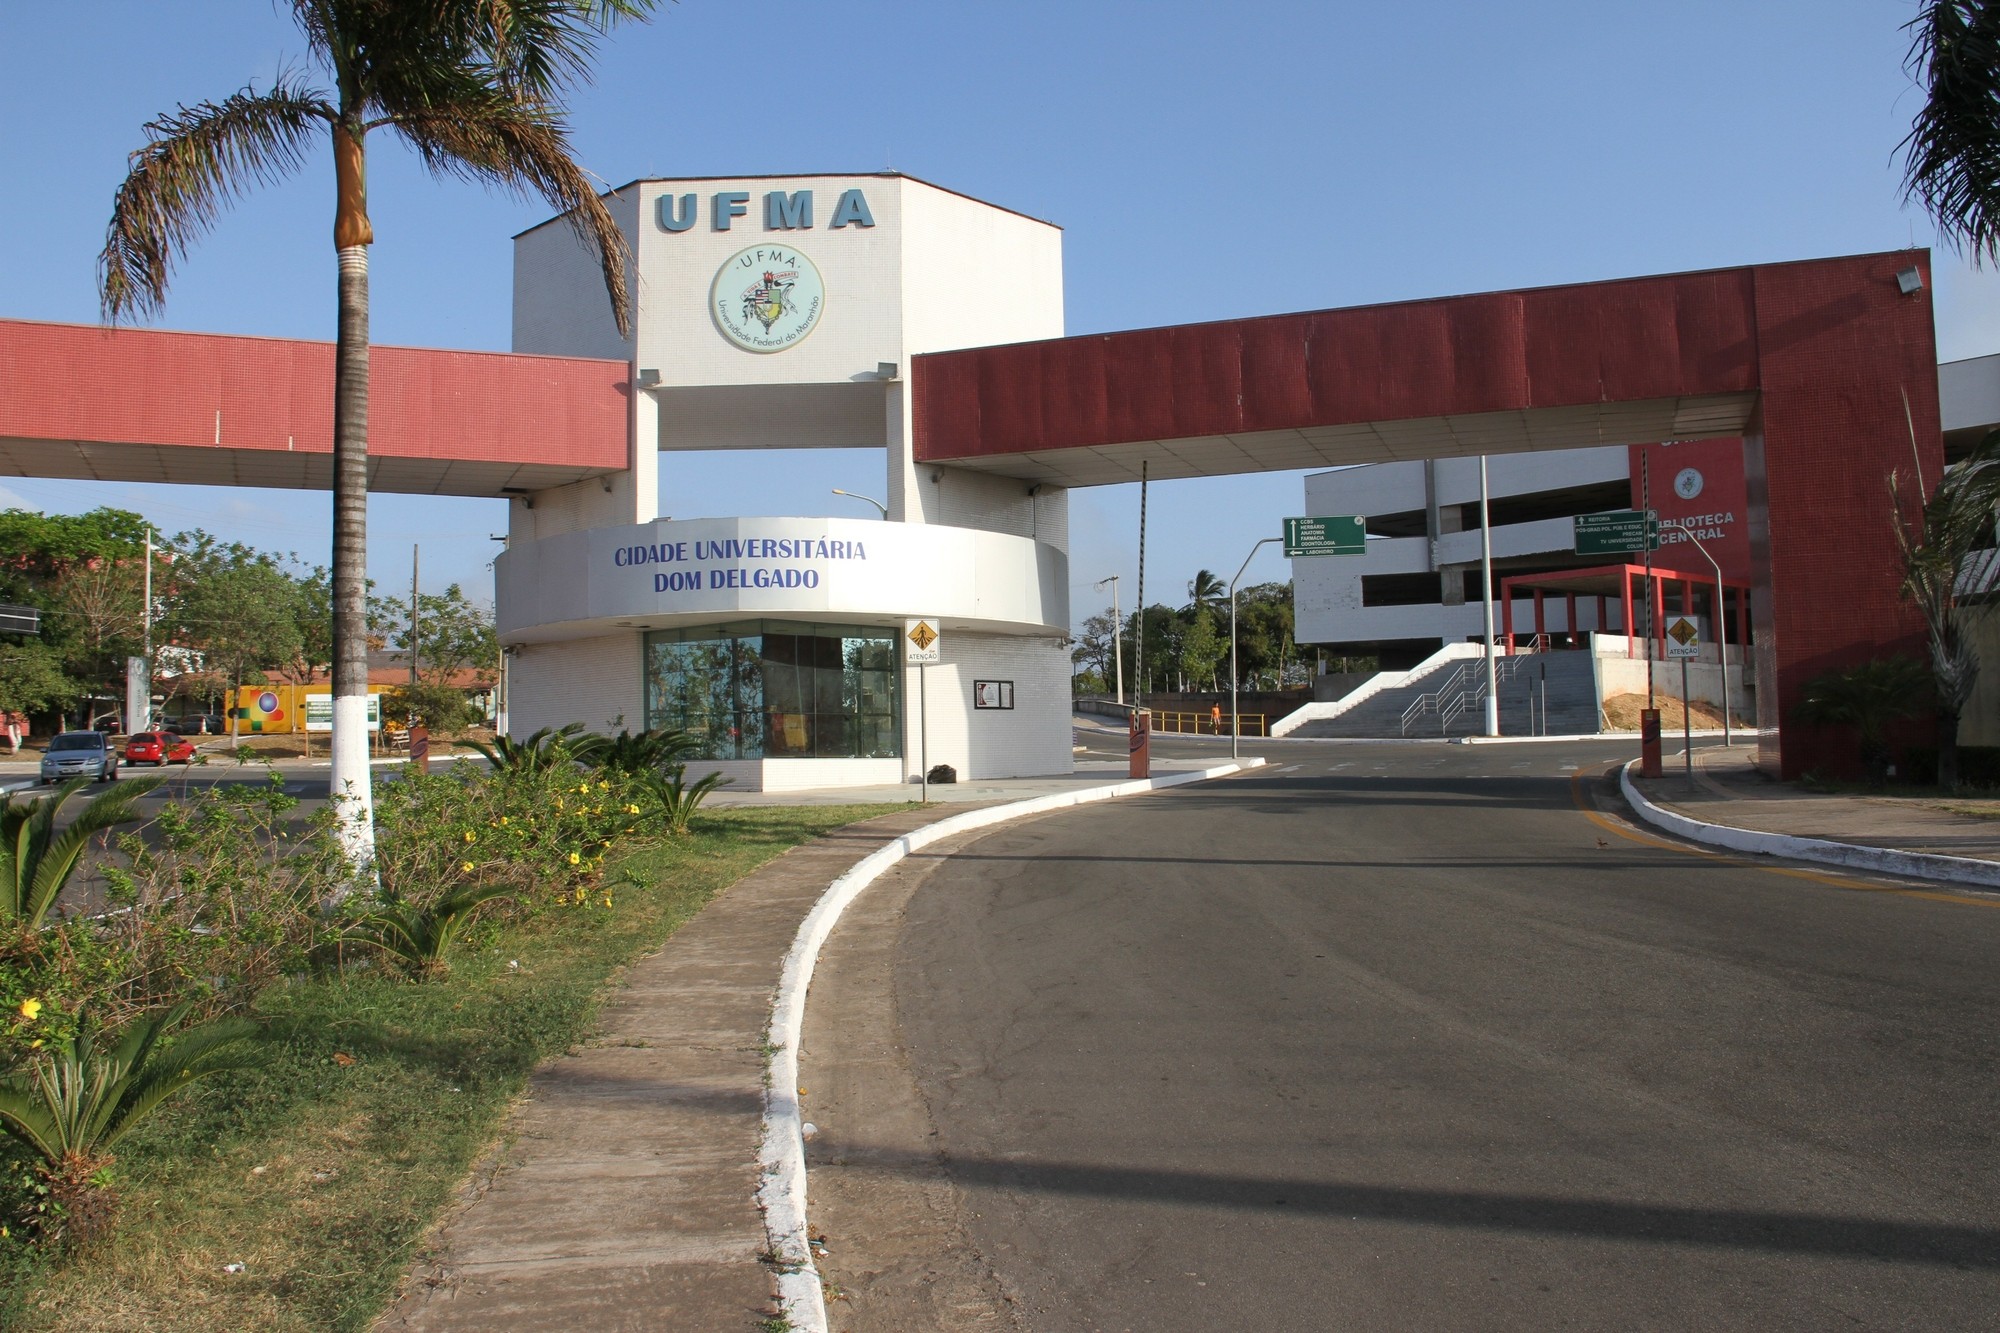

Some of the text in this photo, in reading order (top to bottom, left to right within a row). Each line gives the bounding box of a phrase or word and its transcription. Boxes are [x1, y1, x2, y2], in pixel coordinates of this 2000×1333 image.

[660, 189, 876, 232] UFMA
[740, 250, 796, 269] UFMA
[718, 295, 820, 347] Universidade Federal do Maranhão
[1659, 512, 1734, 531] IBLIOTECA
[615, 535, 867, 567] CIDADE UNIVERSITÁRIA
[654, 568, 819, 593] DOM DELGADO
